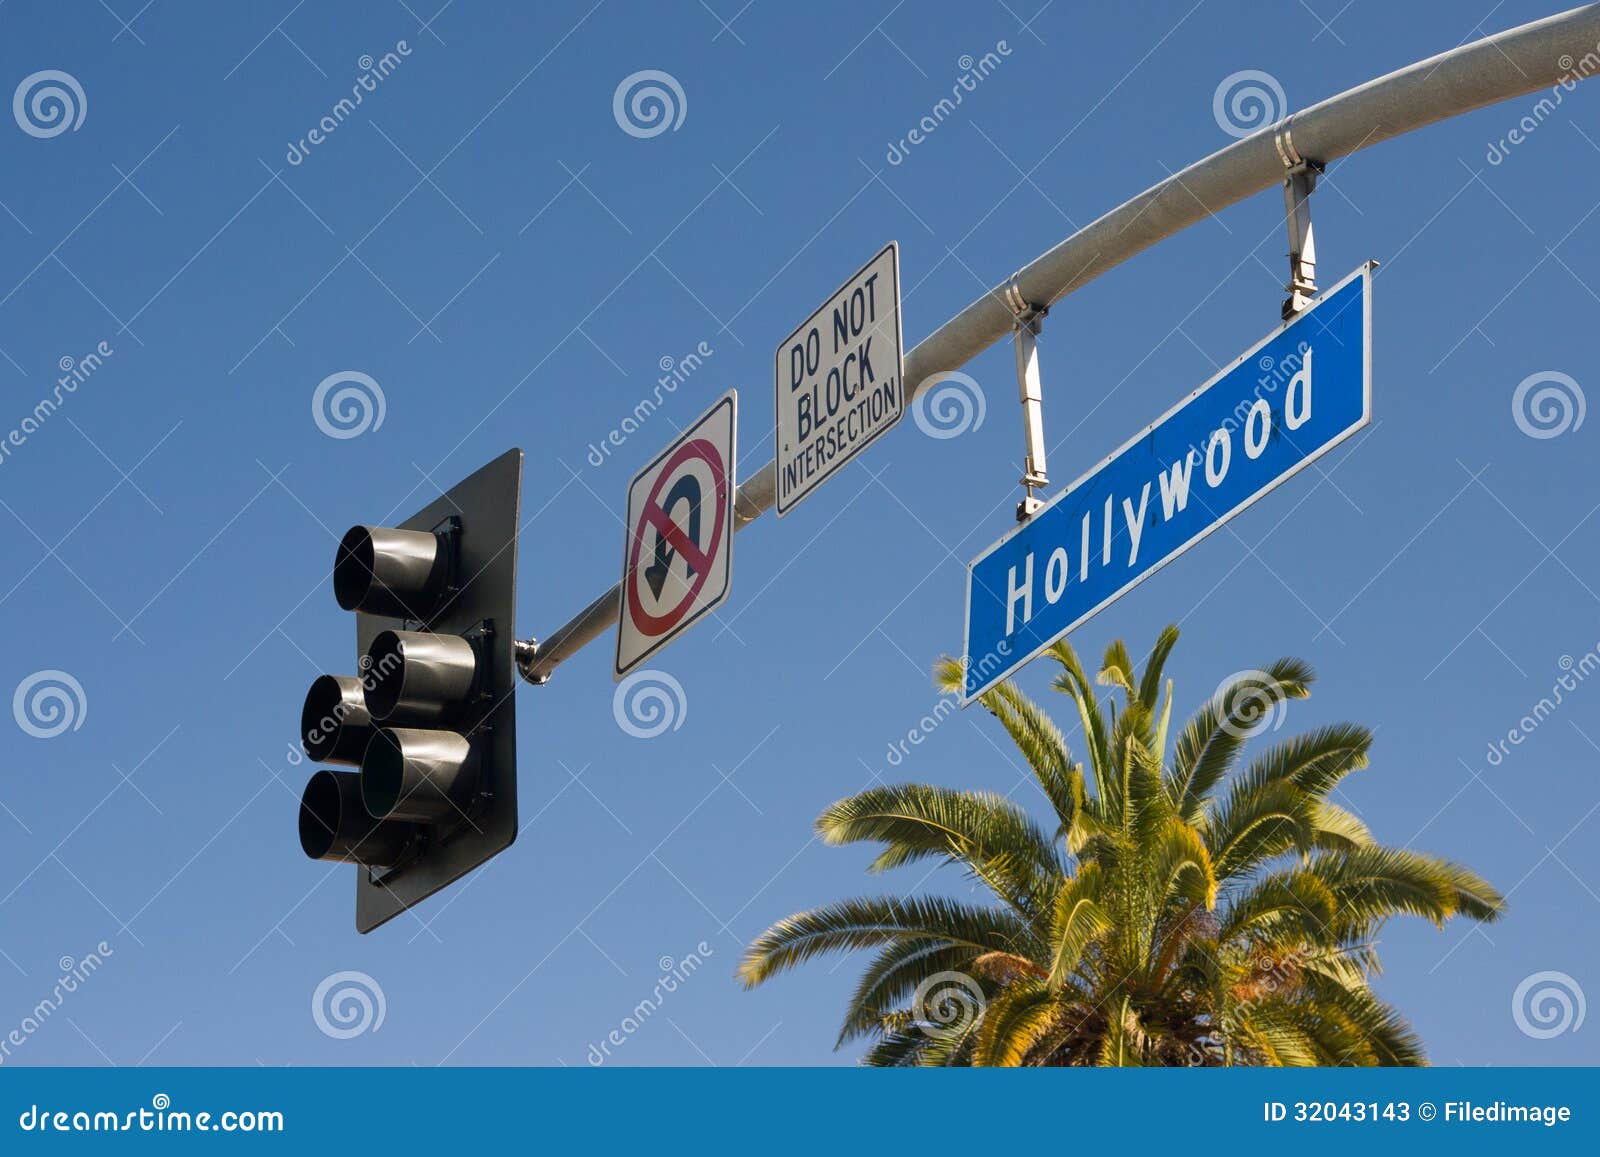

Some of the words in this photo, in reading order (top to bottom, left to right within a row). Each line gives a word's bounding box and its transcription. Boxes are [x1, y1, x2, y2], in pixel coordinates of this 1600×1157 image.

[791, 327, 820, 393] DO
[833, 272, 879, 354] NOT
[797, 336, 875, 445] BLOCK
[782, 377, 896, 498] INTERSECTION
[1005, 346, 1312, 636] Hollywood
